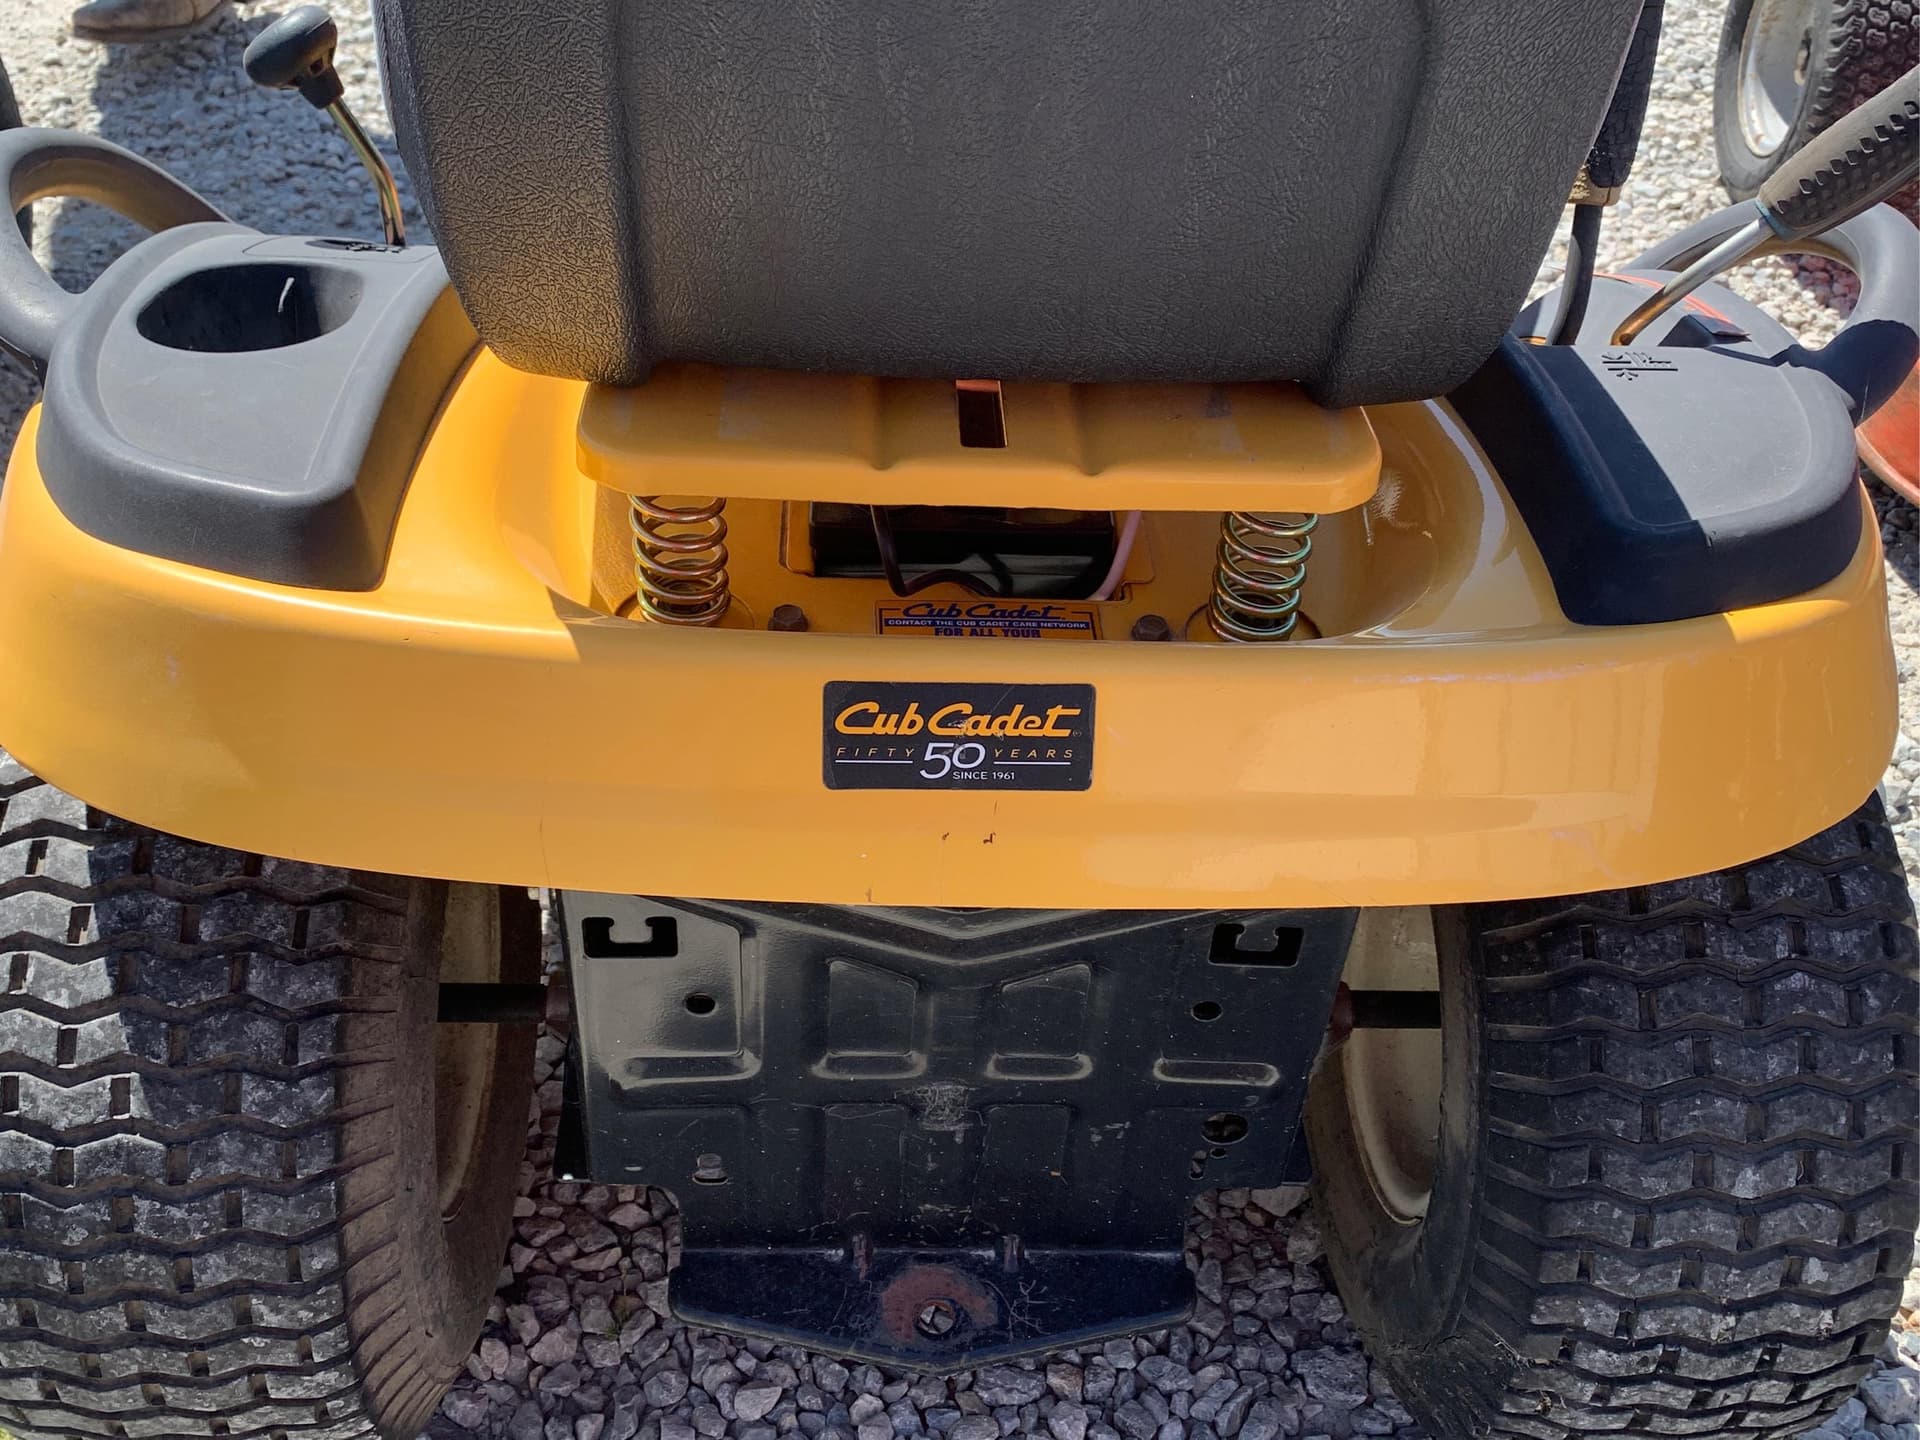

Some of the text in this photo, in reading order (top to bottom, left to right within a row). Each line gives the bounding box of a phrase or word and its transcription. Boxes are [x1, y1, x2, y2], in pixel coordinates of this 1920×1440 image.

[902, 603, 1065, 619] Cub Cadet
[935, 627, 1041, 638] FOR ALL YOUR
[834, 702, 1081, 737] Cub Cadet
[836, 742, 1073, 778] FIFTY 50 YEARS
[952, 771, 1015, 780] SINCE 1961
